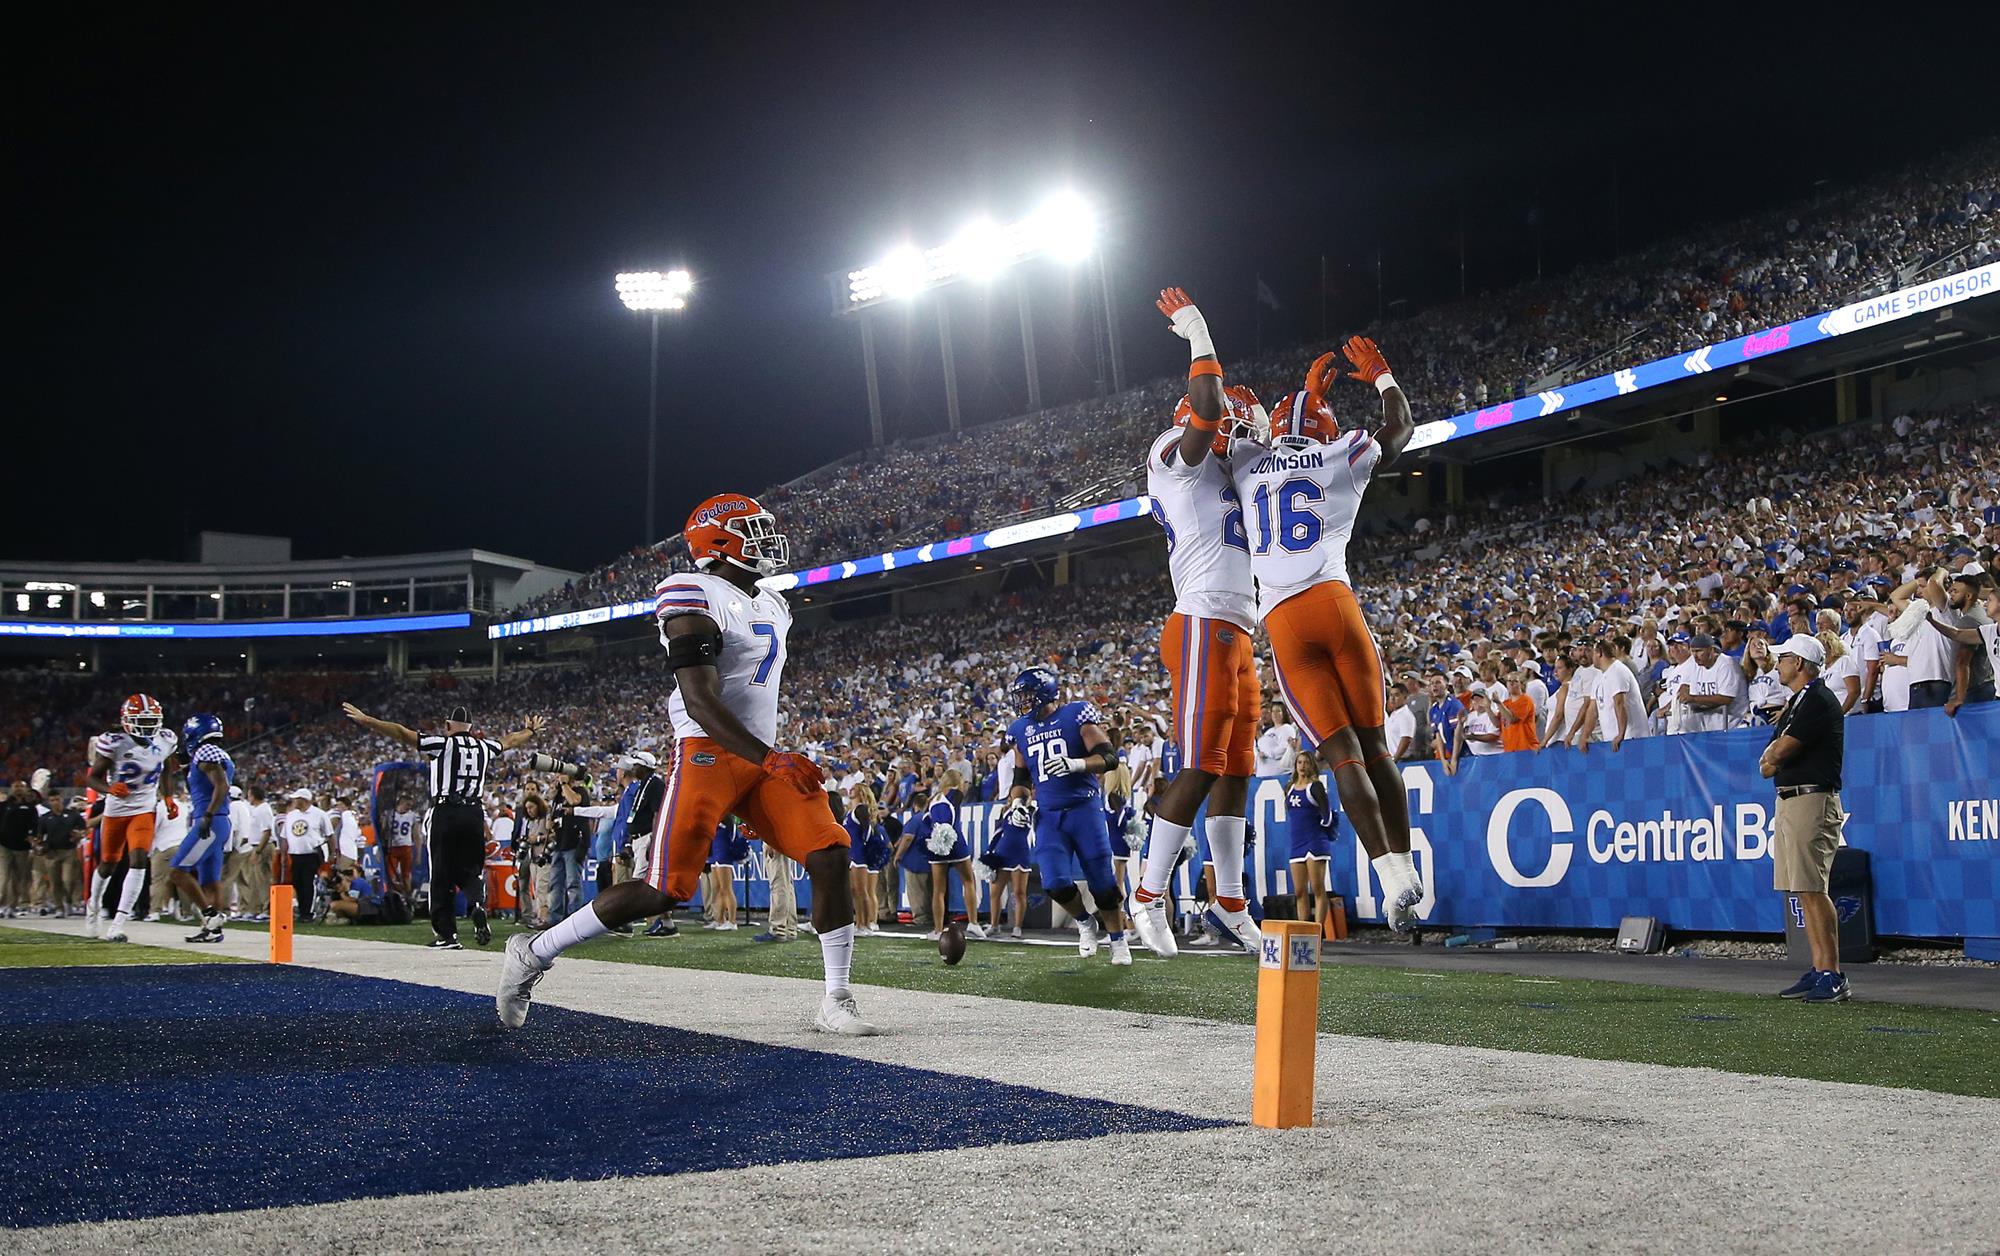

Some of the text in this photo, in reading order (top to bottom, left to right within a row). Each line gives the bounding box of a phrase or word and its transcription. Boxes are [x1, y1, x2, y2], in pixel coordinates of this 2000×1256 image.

[1854, 271, 1992, 324] GAME SPONSOR
[1280, 436, 1309, 446] FLORIDA
[695, 501, 748, 525] Gators
[1252, 476, 1325, 556] 16
[749, 620, 779, 687] 7
[1027, 729, 1062, 745] KENTUCKY
[458, 747, 480, 777] H
[1168, 756, 1174, 773] 1
[119, 761, 161, 790] 24
[1290, 795, 1302, 807] UK
[392, 821, 410, 836] 26
[1949, 800, 2000, 840] KEN
[1587, 804, 1723, 864] Central
[1263, 938, 1280, 964] UK
[1291, 941, 1316, 966] UK
